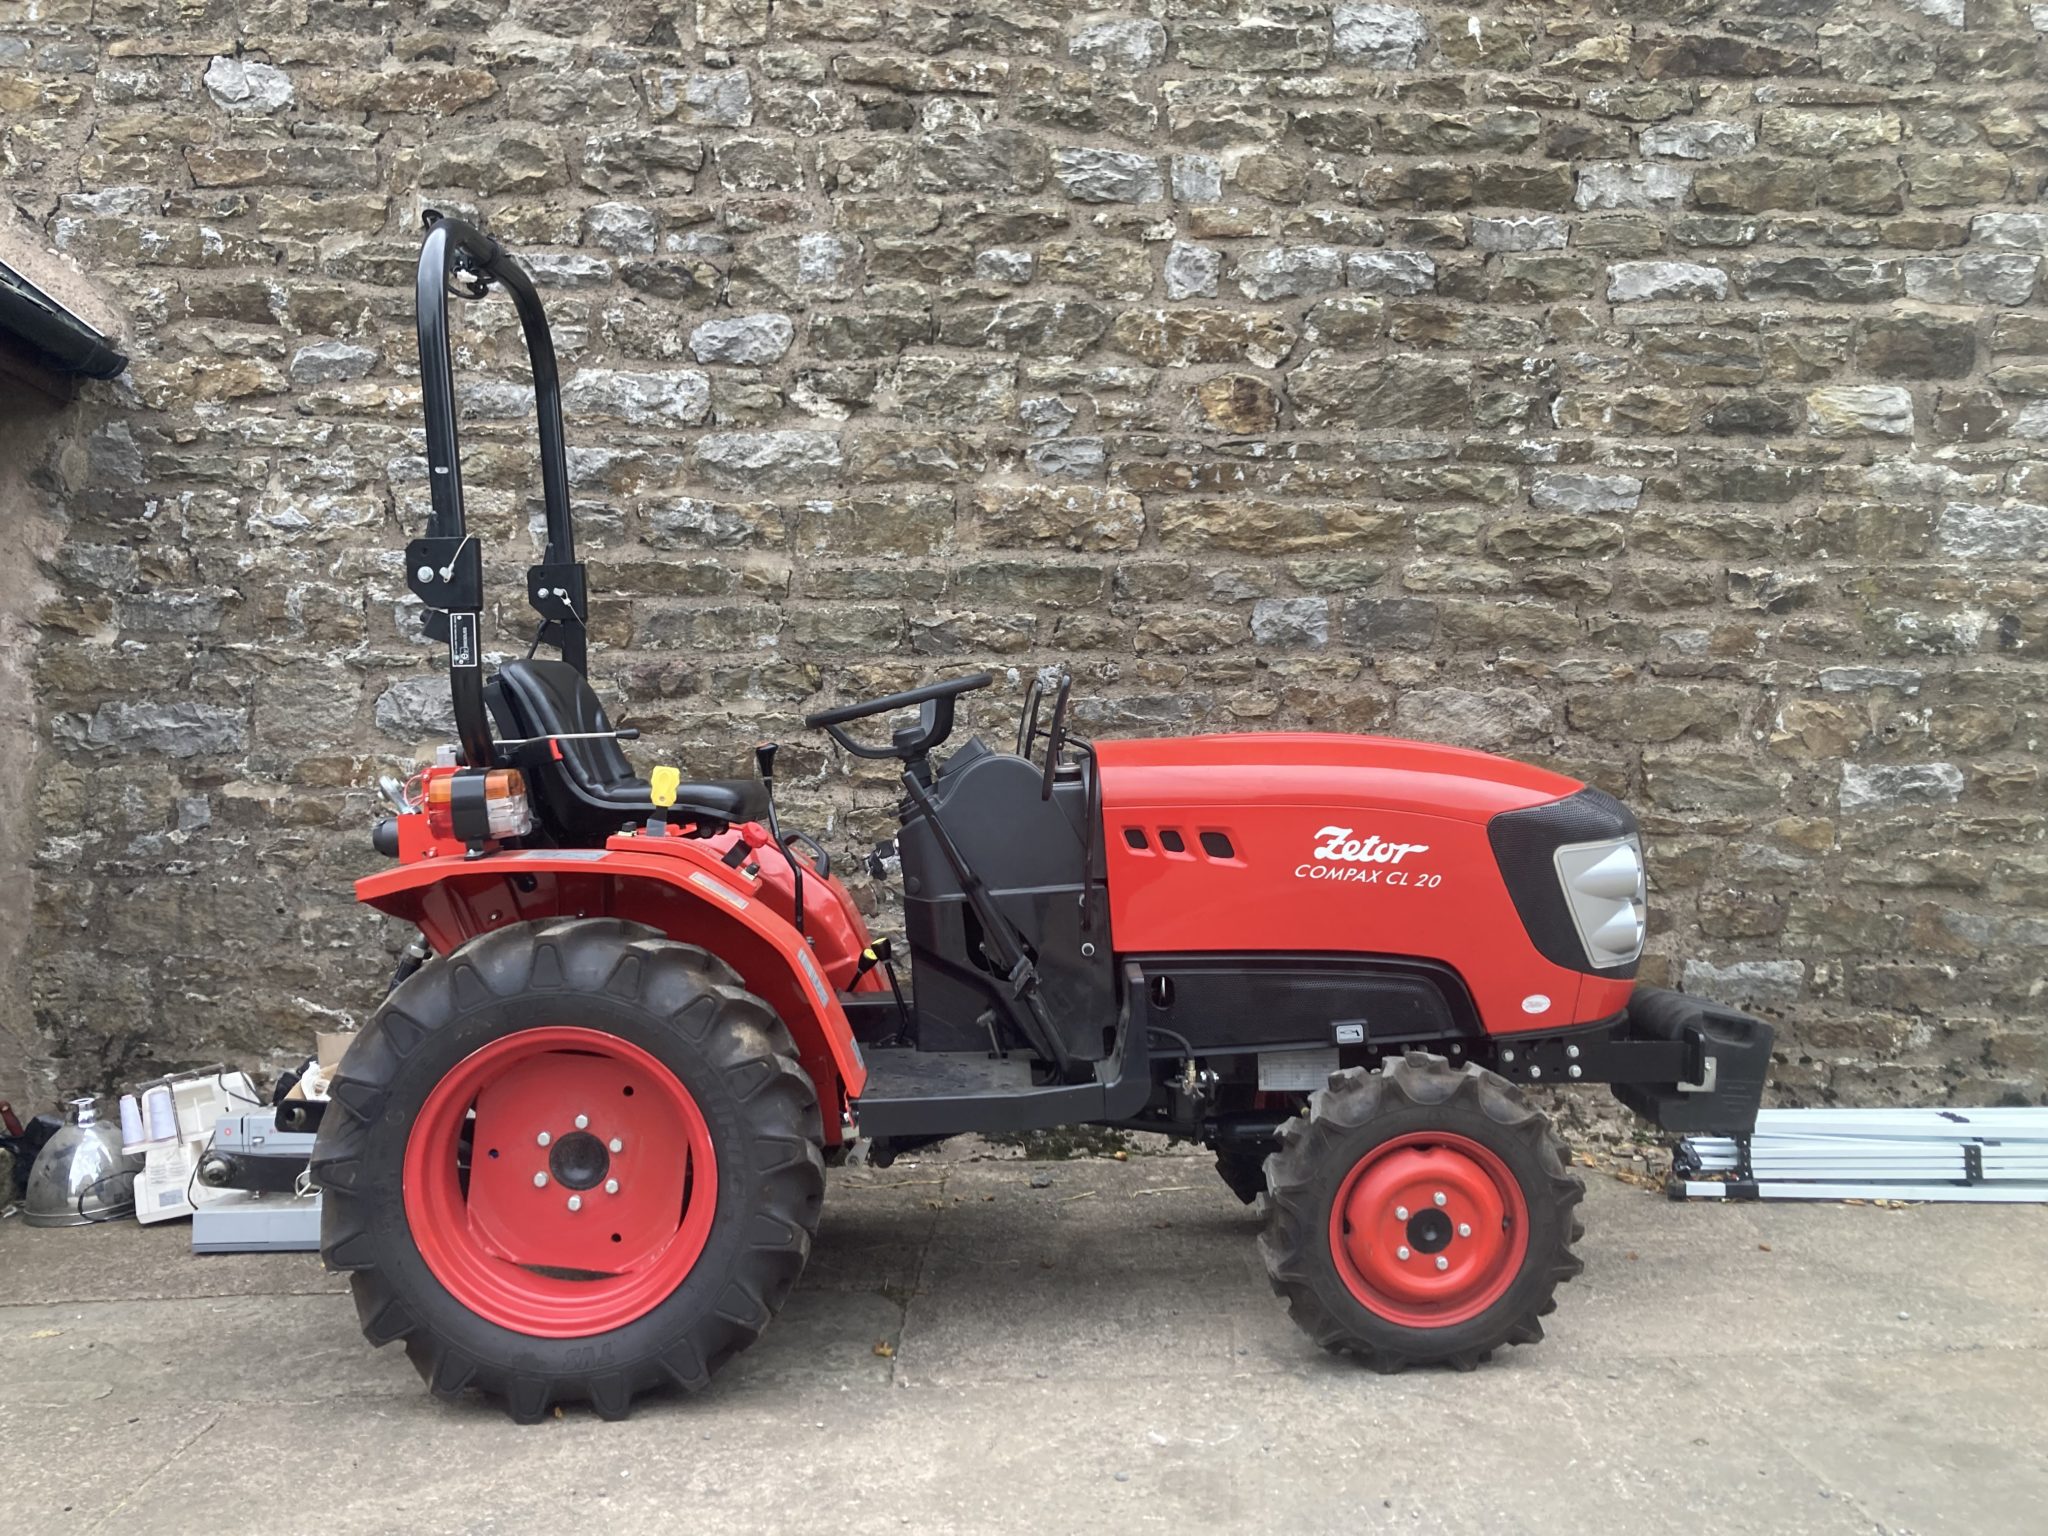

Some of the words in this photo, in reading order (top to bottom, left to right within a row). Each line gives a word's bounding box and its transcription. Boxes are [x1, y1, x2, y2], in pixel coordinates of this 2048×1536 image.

[1313, 825, 1430, 864] Zetor
[1294, 864, 1383, 883] COMPAX
[1385, 871, 1409, 886] CL
[1414, 874, 1442, 888] 20
